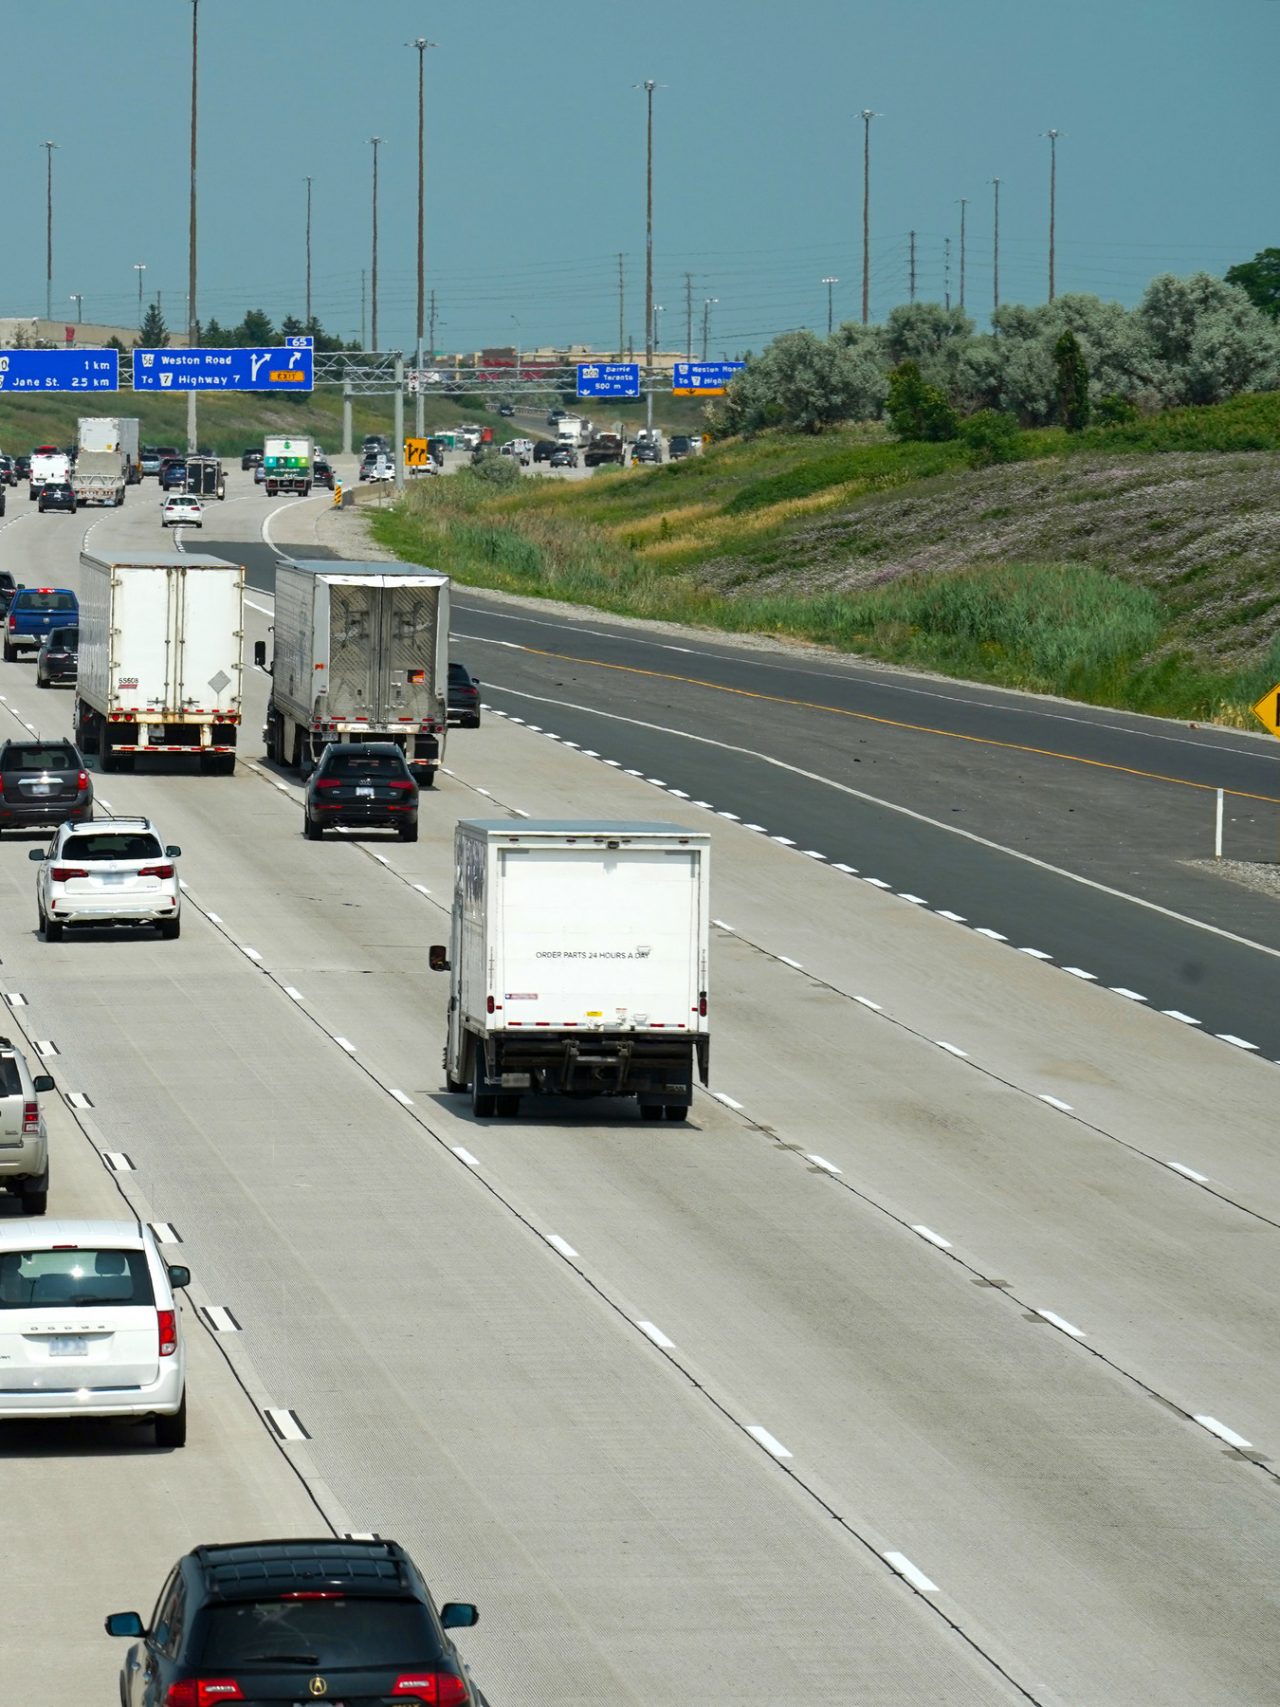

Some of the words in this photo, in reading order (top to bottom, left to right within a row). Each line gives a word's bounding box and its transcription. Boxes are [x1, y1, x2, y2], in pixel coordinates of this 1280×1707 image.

[292, 339, 307, 347] 65
[161, 356, 200, 365] Weston
[205, 356, 232, 365] Road
[84, 361, 90, 370] 1
[93, 361, 110, 370] km
[12, 378, 40, 386] Jane
[45, 378, 60, 386] St.
[93, 378, 110, 386] km
[141, 376, 154, 384] To
[163, 375, 170, 385] 7
[179, 375, 228, 387] Highway
[233, 375, 241, 384] 7
[595, 382, 610, 390] 500
[535, 951, 561, 959] ORDER
[563, 951, 586, 959] PARTS
[588, 951, 598, 959] 24
[599, 951, 626, 959] HOURS
